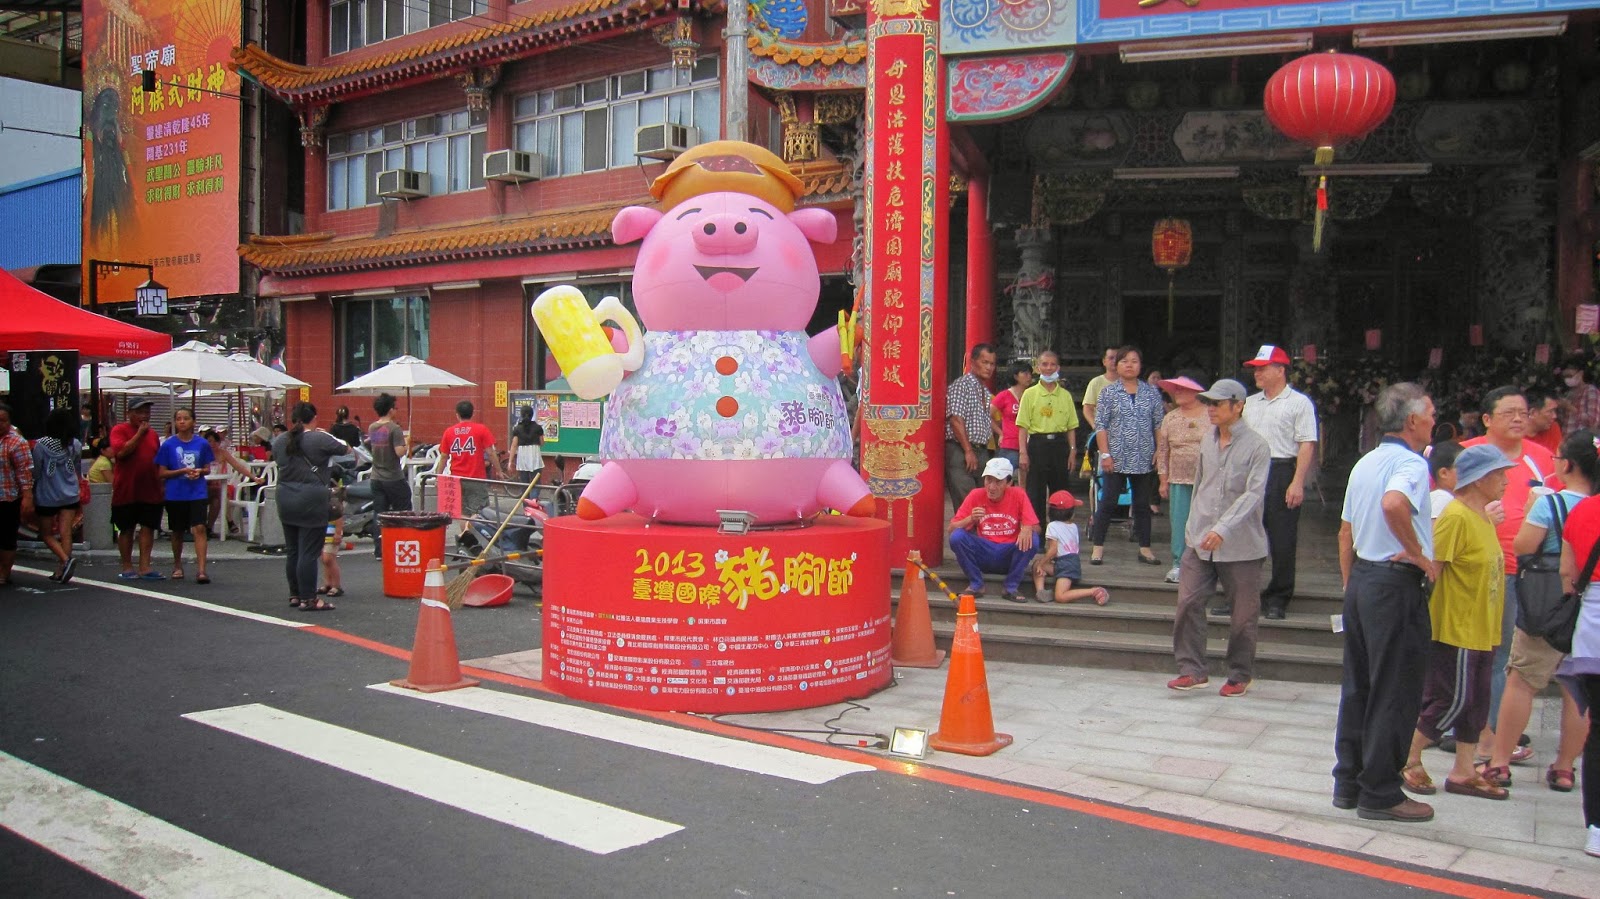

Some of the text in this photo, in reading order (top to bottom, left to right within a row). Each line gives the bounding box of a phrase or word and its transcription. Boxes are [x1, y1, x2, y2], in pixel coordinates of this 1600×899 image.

[131, 45, 176, 76] 聖帝廟
[146, 140, 188, 162] 開基231年
[146, 154, 224, 183] 武聖關公 靈驗非凡
[146, 176, 224, 204] 求財得財 求利得利
[780, 400, 835, 430] 豬腳節
[450, 436, 477, 457] 44
[634, 548, 706, 578] 2013
[632, 546, 855, 611] 臺灣國際 豬腳節
